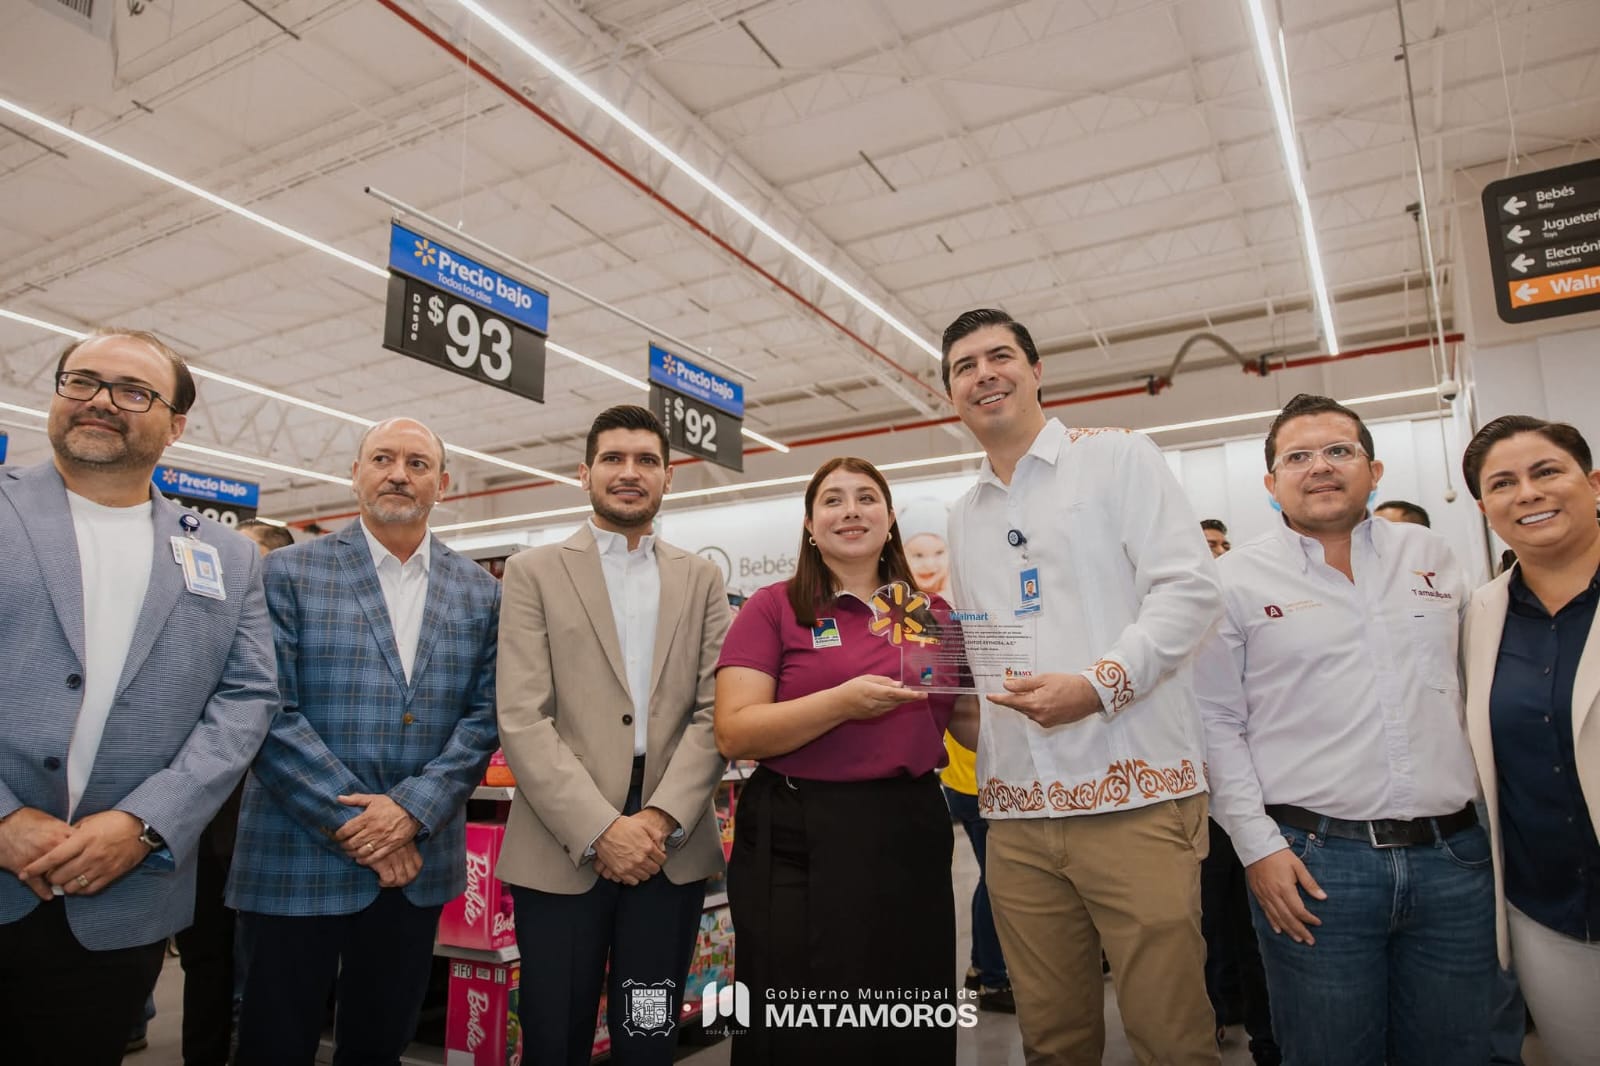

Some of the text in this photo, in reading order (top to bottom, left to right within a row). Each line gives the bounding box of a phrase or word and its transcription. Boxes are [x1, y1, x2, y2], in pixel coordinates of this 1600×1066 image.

[1536, 186, 1575, 202] Bebés
[437, 272, 462, 292] Todos
[463, 284, 475, 297] los
[438, 251, 532, 309] Precio bajo
[427, 295, 512, 381] $93
[677, 362, 711, 389] Precio
[711, 375, 734, 400] bajo
[673, 397, 717, 452] $92
[179, 473, 219, 491] Precio
[220, 480, 247, 497] bajo
[740, 553, 796, 577] Bebés
[949, 611, 989, 621] Walmart
[464, 851, 489, 927] Barbie
[467, 988, 489, 1052] Barbie
